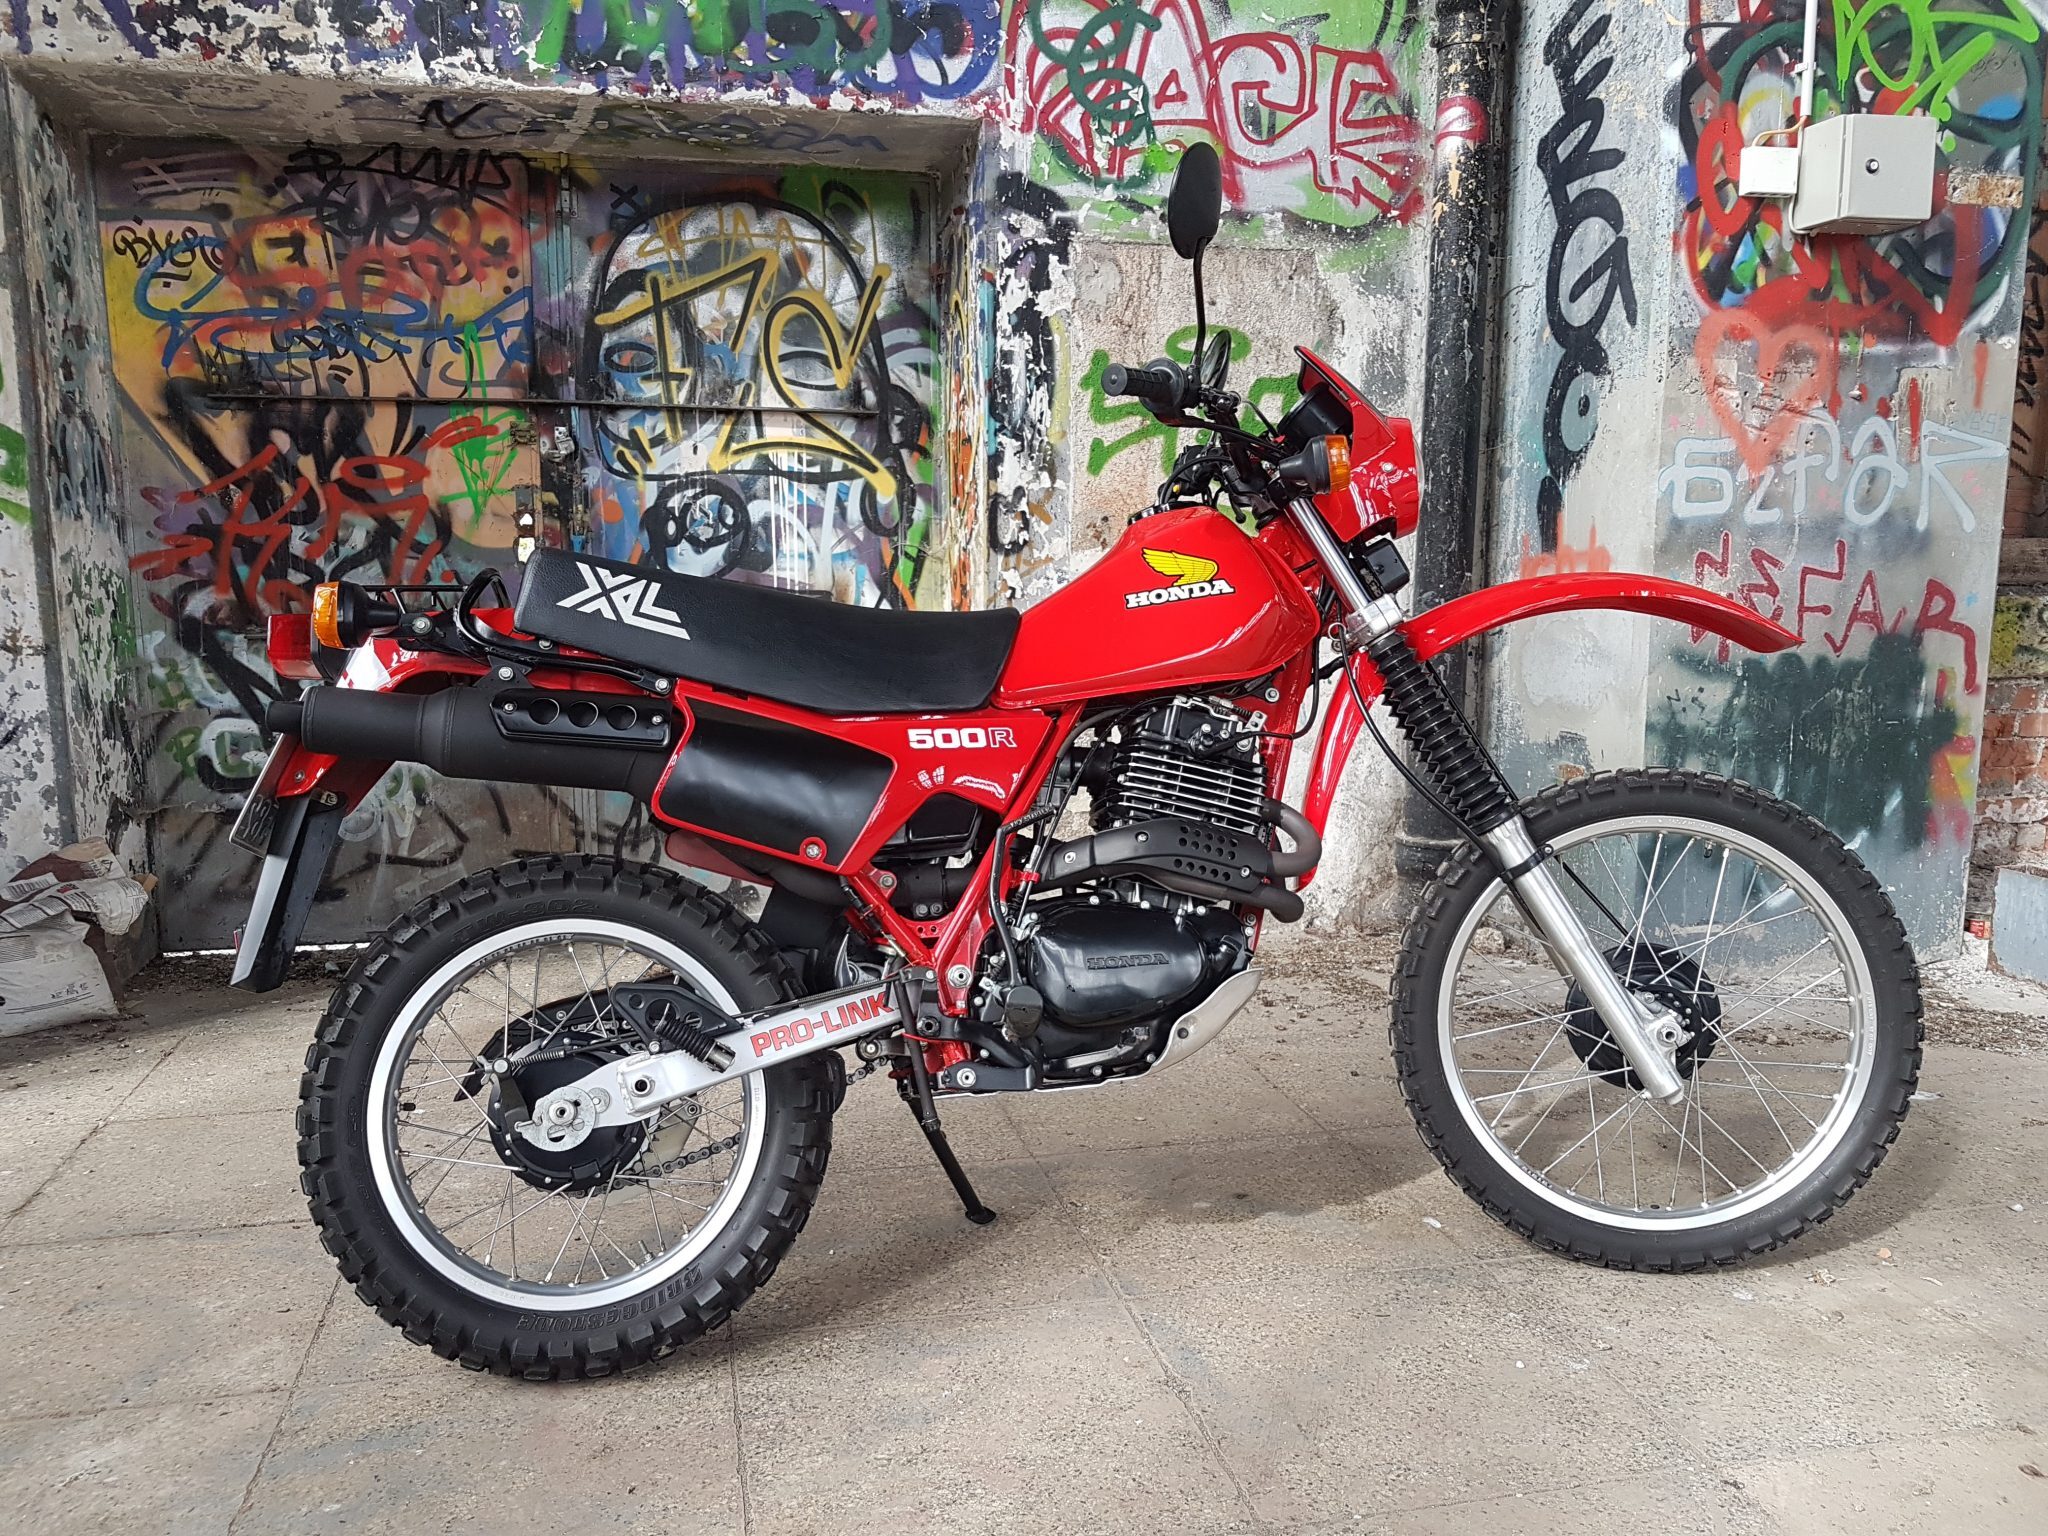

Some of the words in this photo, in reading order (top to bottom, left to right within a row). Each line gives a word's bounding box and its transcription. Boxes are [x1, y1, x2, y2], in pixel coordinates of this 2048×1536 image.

[1124, 578, 1236, 609] HONDA
[1086, 953, 1170, 971] HONDA
[750, 991, 895, 1057] PRO-LINK
[516, 1263, 704, 1332] BRIDGESTONE
